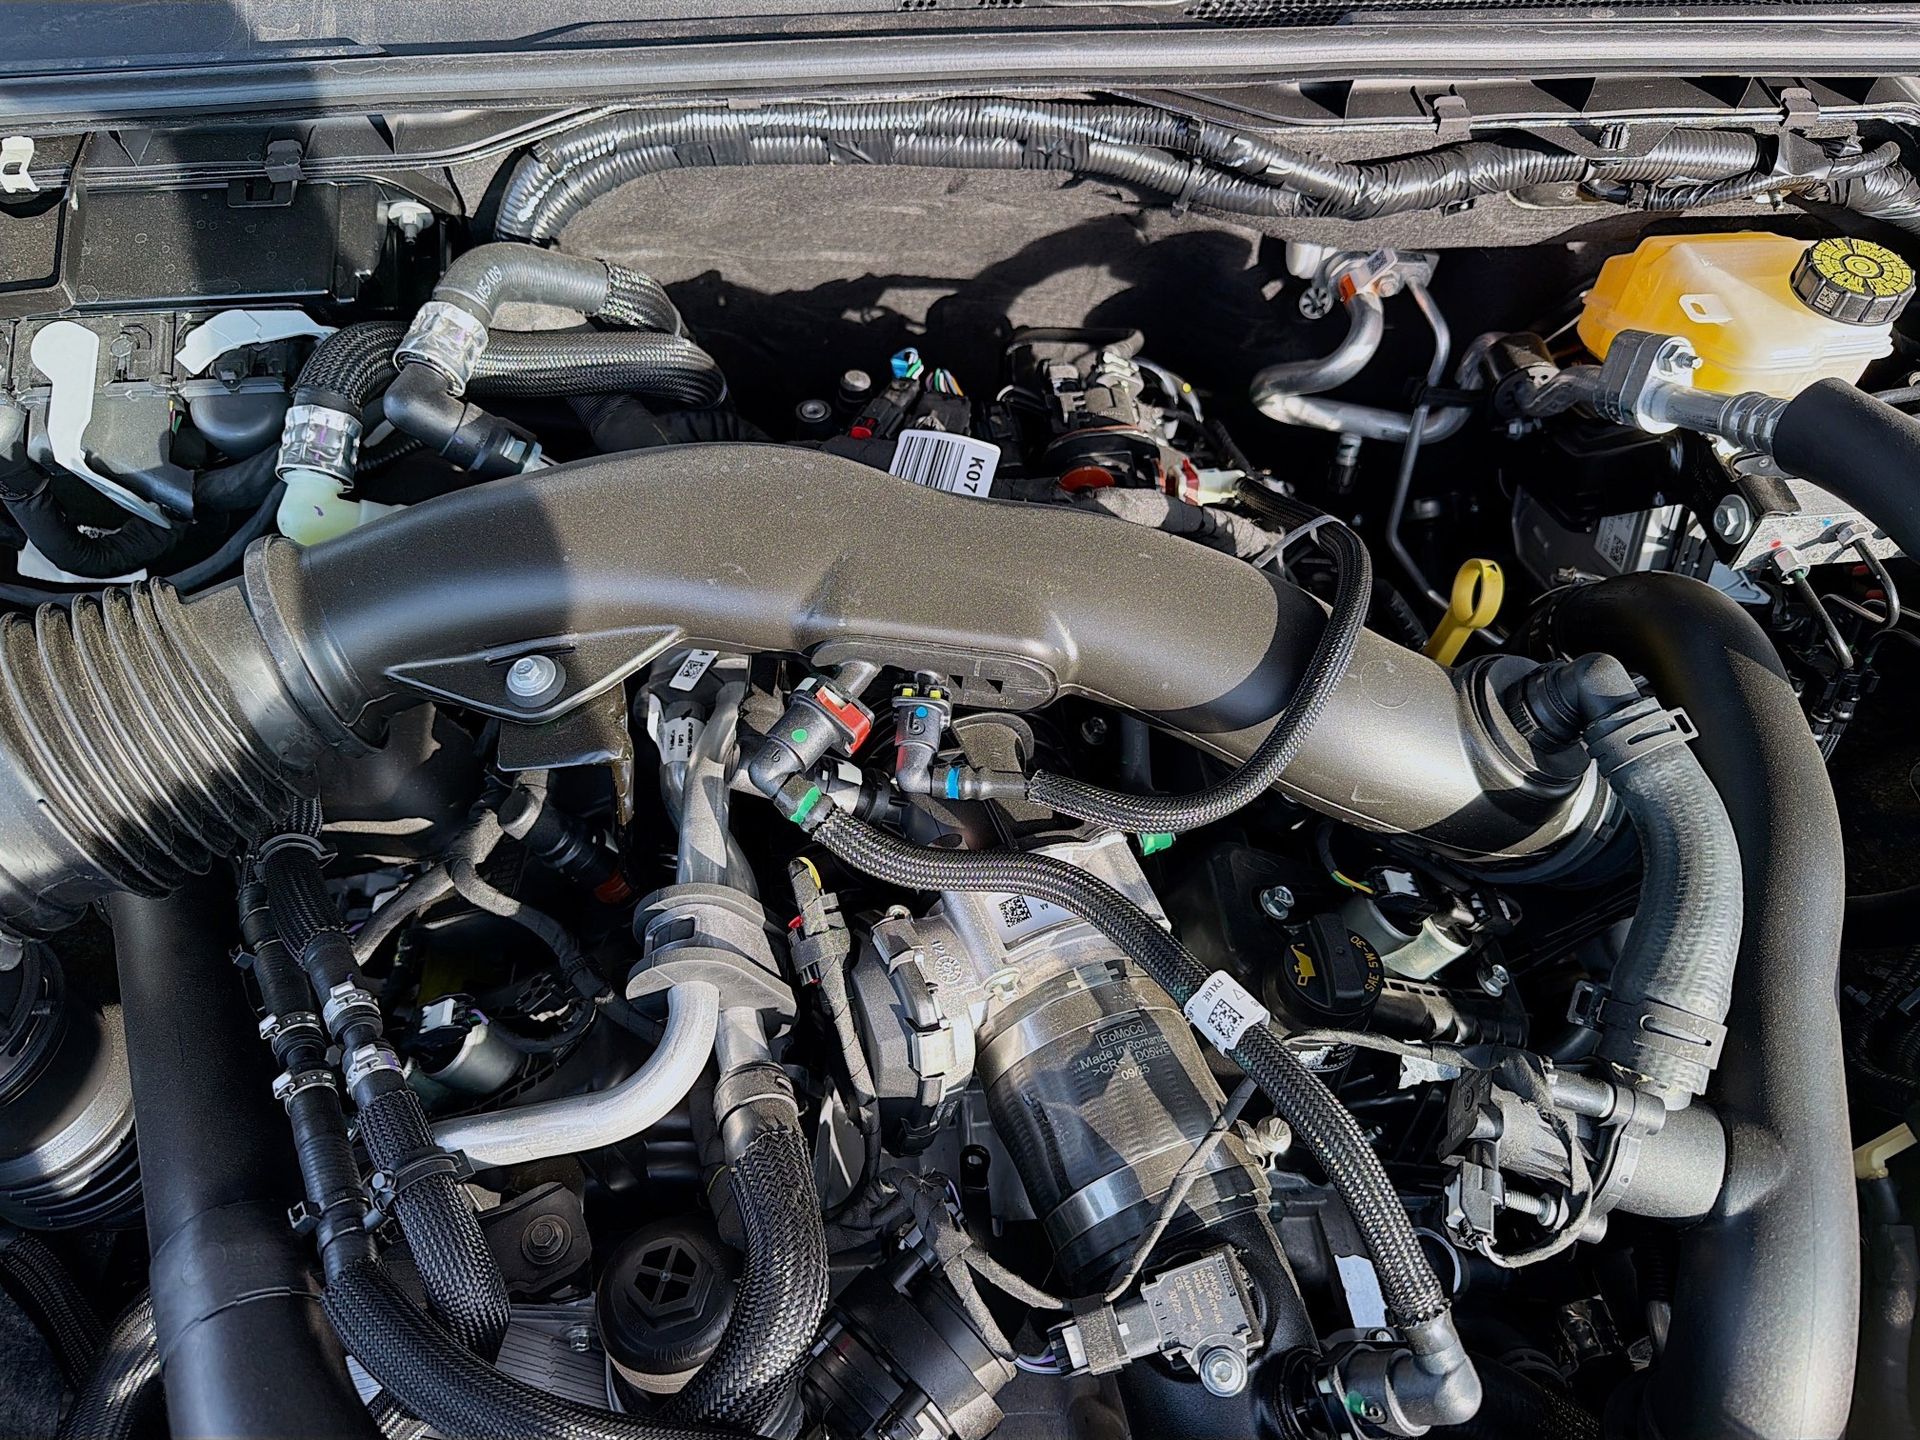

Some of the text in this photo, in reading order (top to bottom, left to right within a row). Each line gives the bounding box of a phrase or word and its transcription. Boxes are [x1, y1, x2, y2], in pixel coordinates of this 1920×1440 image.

[963, 456, 986, 494] K07
[1350, 935, 1380, 992] SAE 5W-30
[1201, 978, 1225, 1004] FXL6E
[1099, 1024, 1145, 1046] FoMoCo
[1079, 1034, 1167, 1071] Made in Romania
[1121, 1063, 1151, 1081] 09/25
